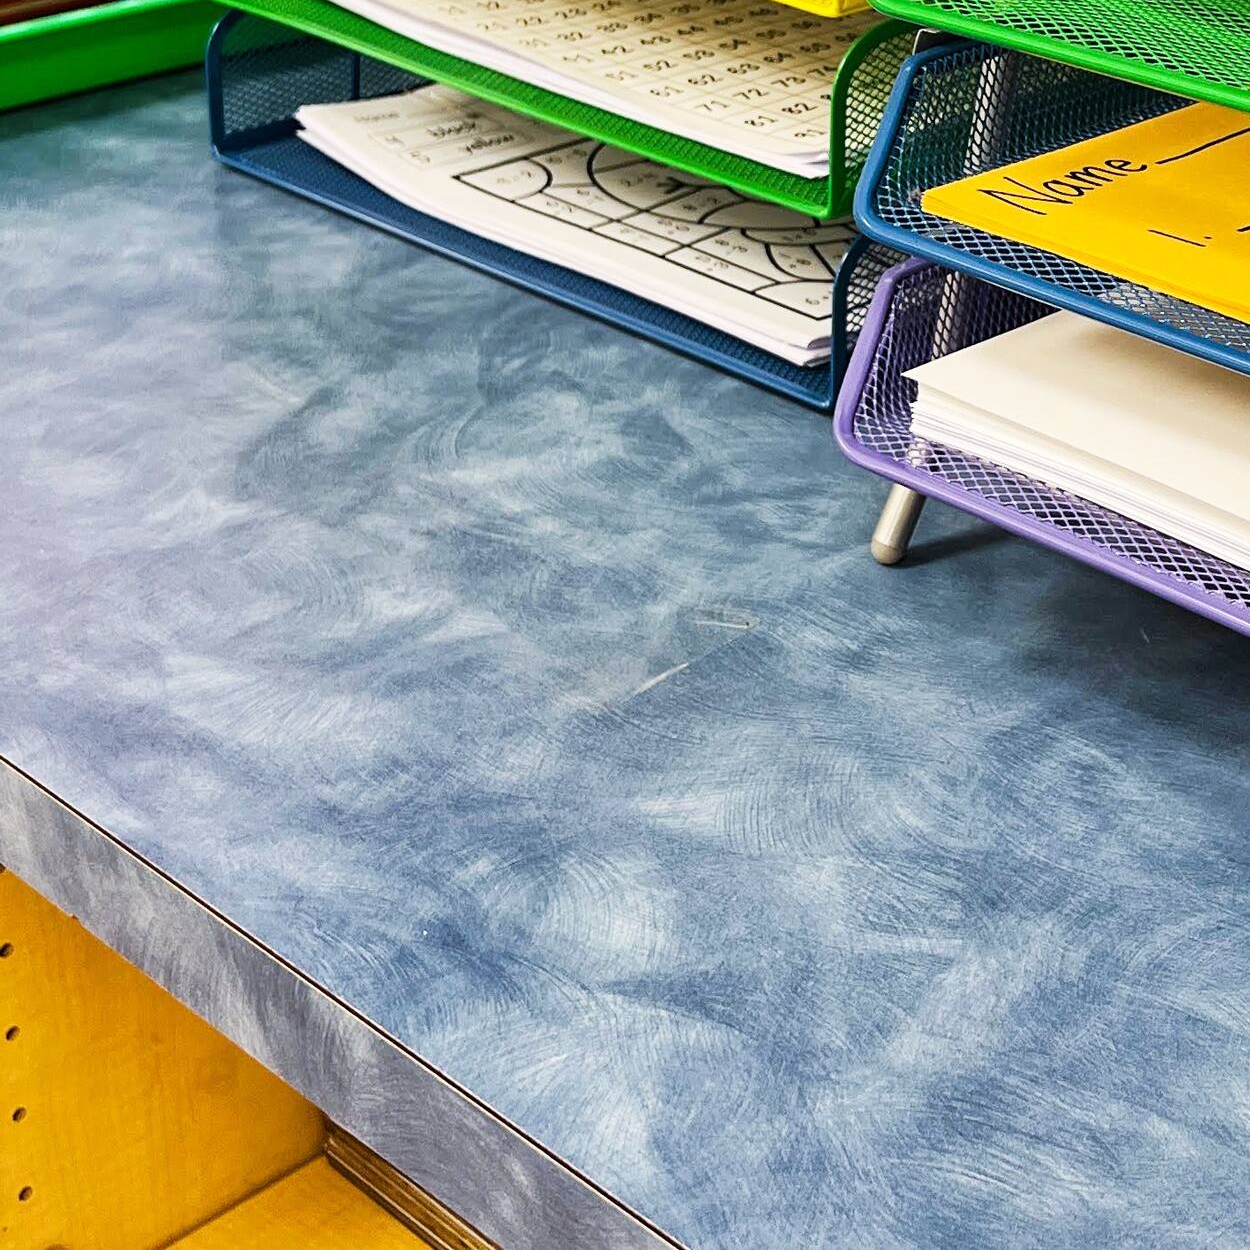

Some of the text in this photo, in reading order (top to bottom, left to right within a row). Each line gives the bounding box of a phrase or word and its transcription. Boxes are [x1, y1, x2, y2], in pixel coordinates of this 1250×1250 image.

[694, 100, 730, 112] 71
[732, 88, 771, 100] 72
[781, 102, 819, 115] 82
[976, 157, 1148, 216] Name
[1147, 228, 1212, 248] 1.
